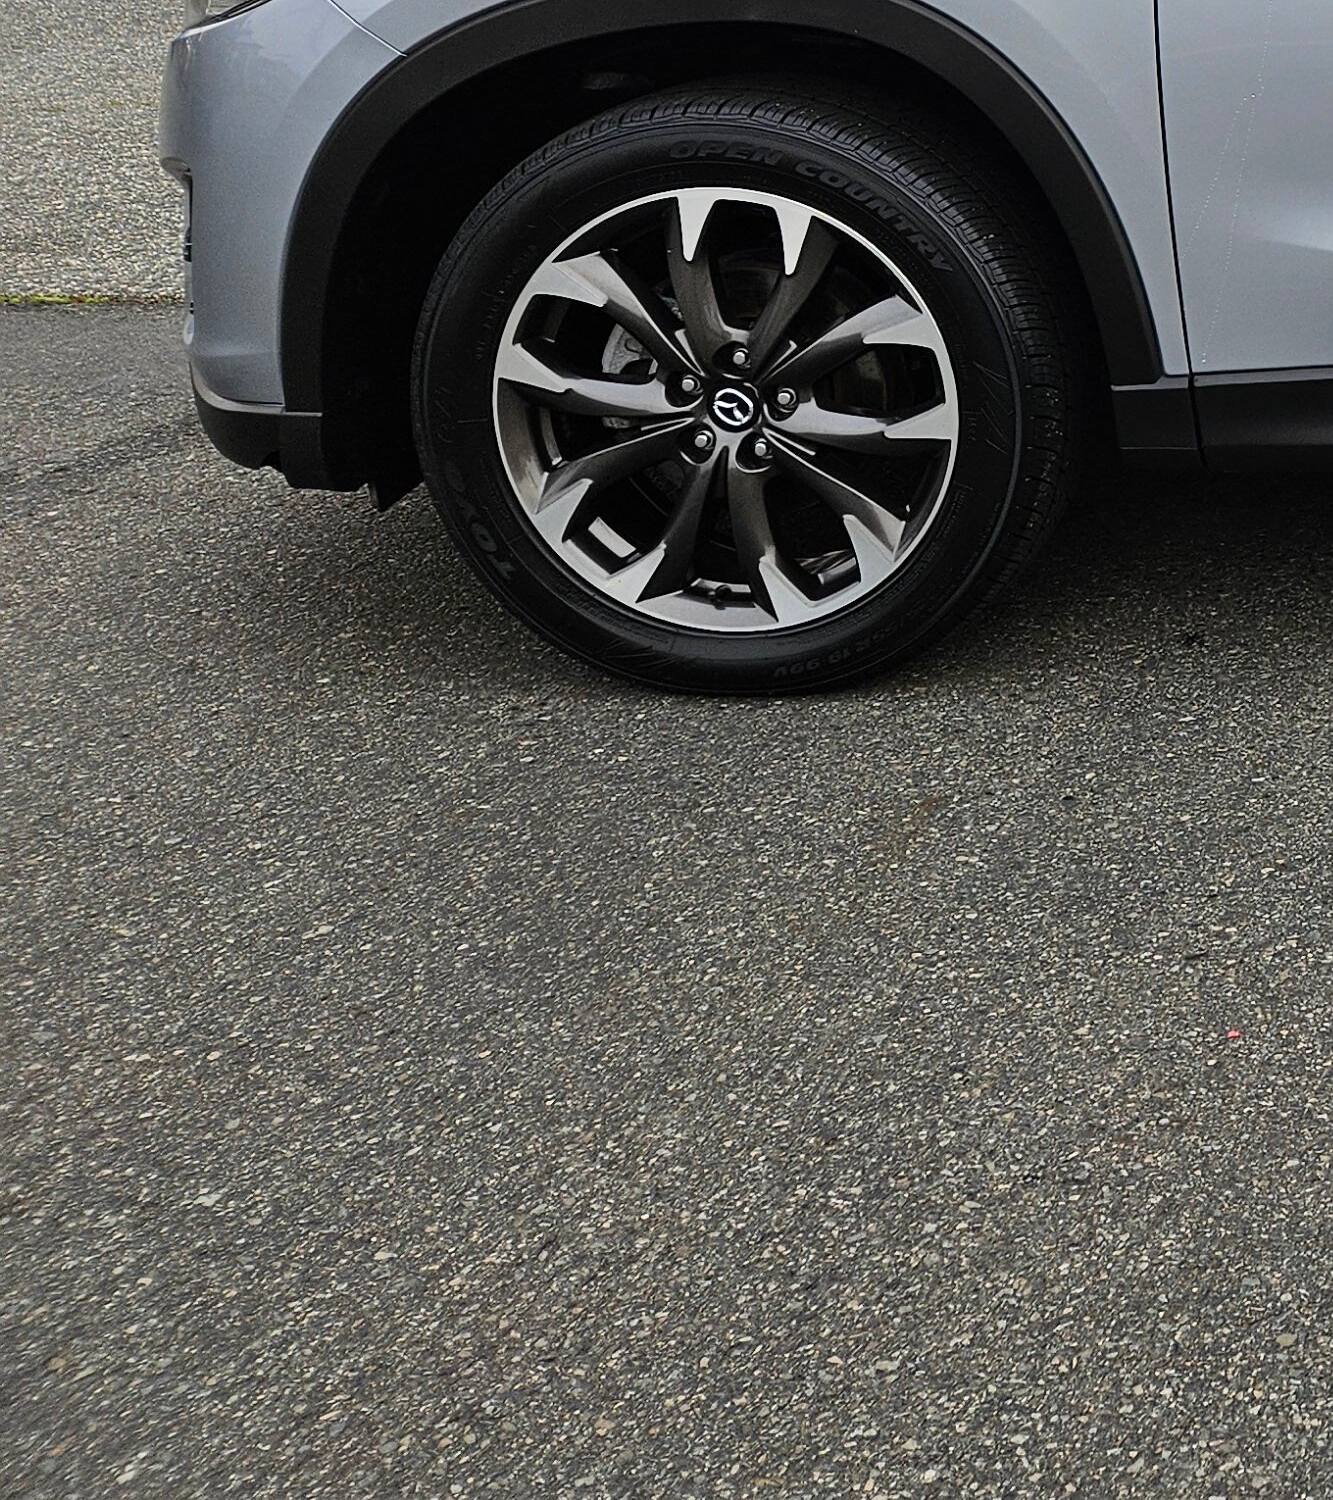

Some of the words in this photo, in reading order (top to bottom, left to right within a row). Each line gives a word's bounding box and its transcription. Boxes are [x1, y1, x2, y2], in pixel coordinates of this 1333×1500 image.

[668, 140, 784, 166] OPEN
[794, 160, 954, 273] COUNTRY
[446, 468, 516, 581] TOYO
